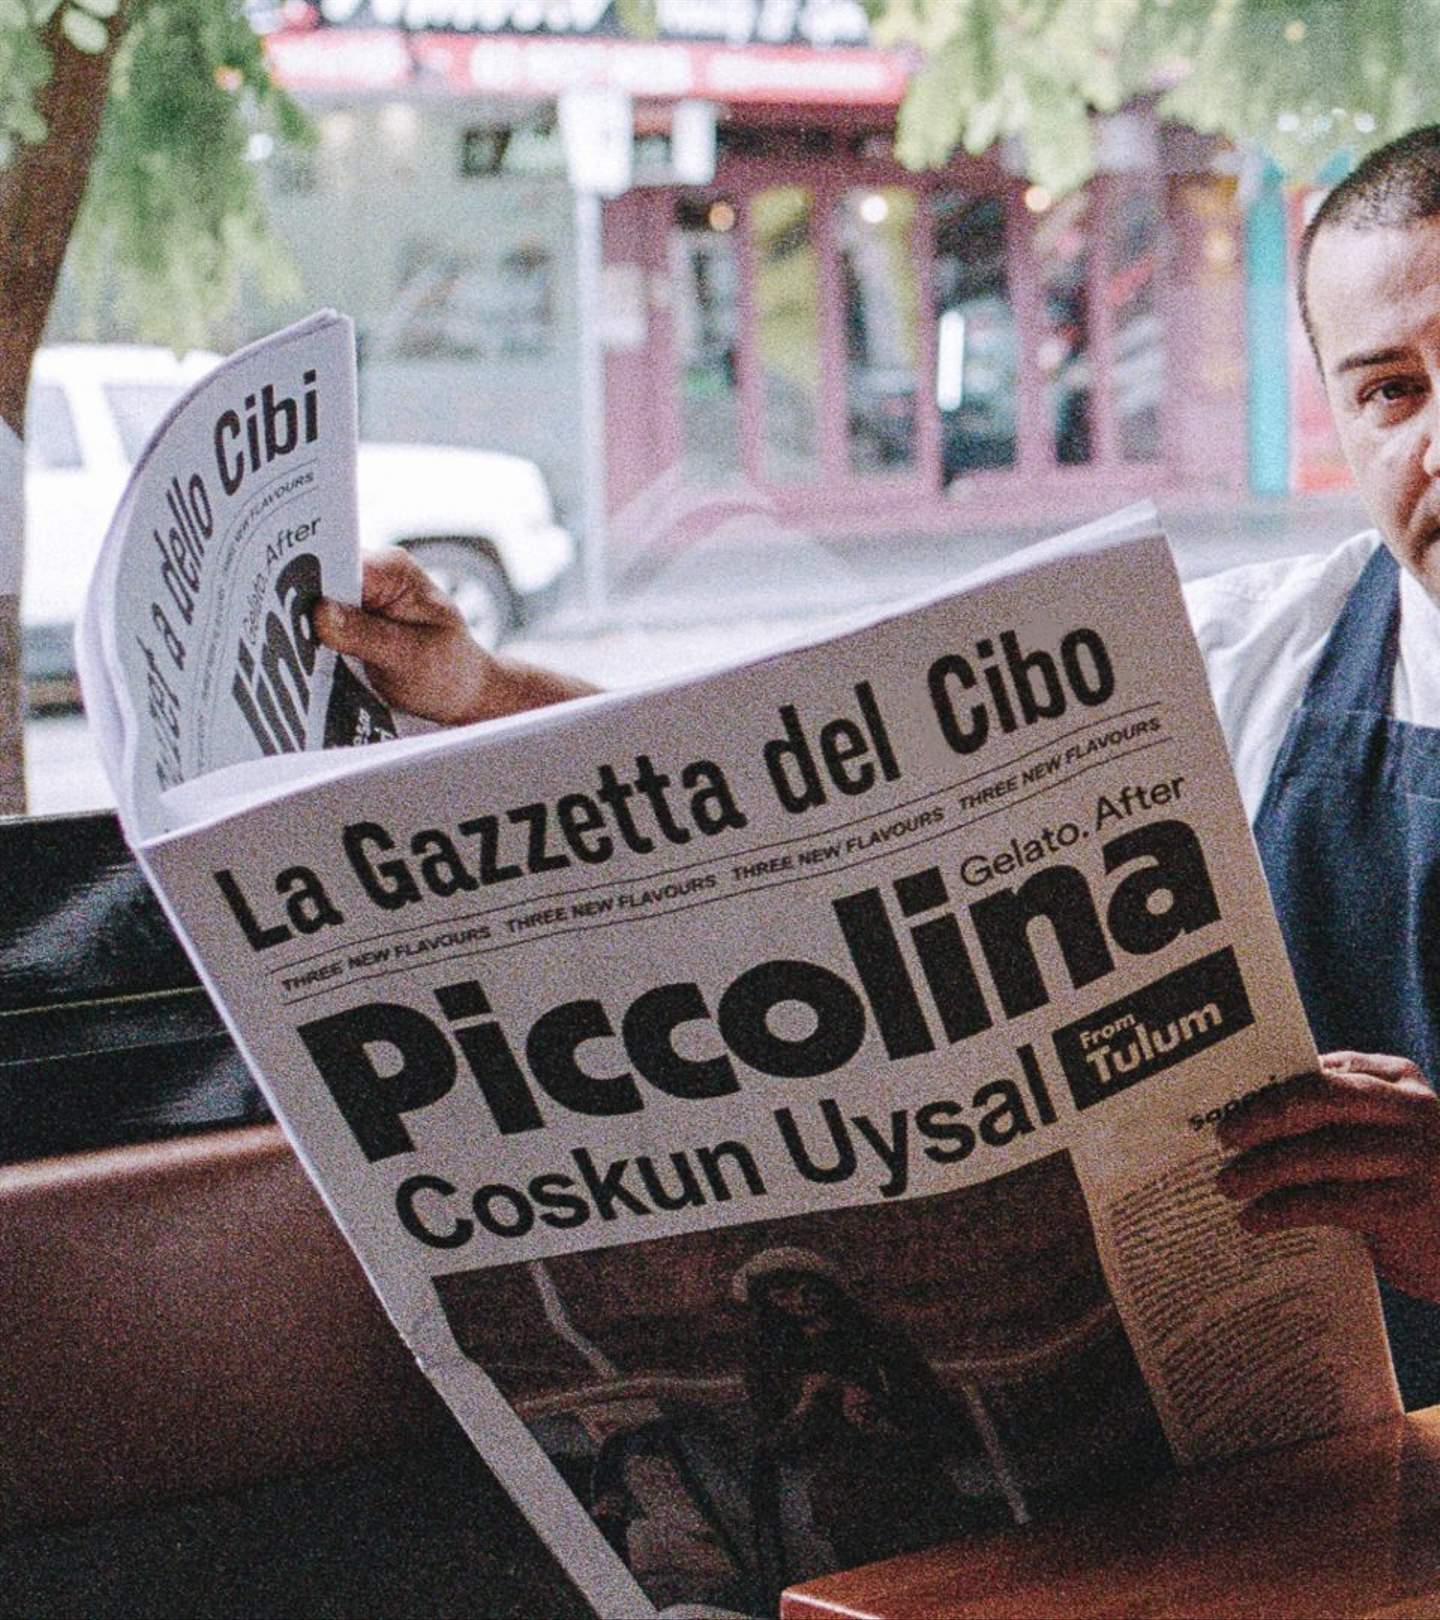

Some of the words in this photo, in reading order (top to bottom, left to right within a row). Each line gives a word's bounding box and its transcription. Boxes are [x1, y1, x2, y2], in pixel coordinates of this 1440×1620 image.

[154, 474, 214, 624] dello
[214, 369, 319, 497] Cibi
[265, 516, 323, 573] After
[214, 864, 344, 952] La
[342, 755, 748, 911] Gazzetta
[763, 681, 902, 815] del
[927, 627, 1116, 755] Cibo
[282, 961, 343, 991] THREE
[349, 947, 390, 971] NEW
[394, 926, 491, 959] FLAVOURS
[507, 908, 568, 933] THREE
[572, 895, 614, 919] NEW
[618, 873, 718, 909] FLAVOURS
[732, 857, 795, 882] THREE
[799, 843, 841, 867] NEW
[846, 807, 945, 854] FLAVOURS
[958, 778, 1019, 812] THREE
[1022, 755, 1062, 785] NEW
[1065, 717, 1161, 766] FLAVOURS
[959, 820, 1090, 888] Gelato.
[1094, 777, 1186, 831] After
[297, 820, 1222, 1163] Piccolina
[1079, 1013, 1137, 1049] From
[1085, 1002, 1223, 1084] Tulum
[395, 1138, 768, 1250] Coskun
[774, 1043, 1059, 1199] Uysal
